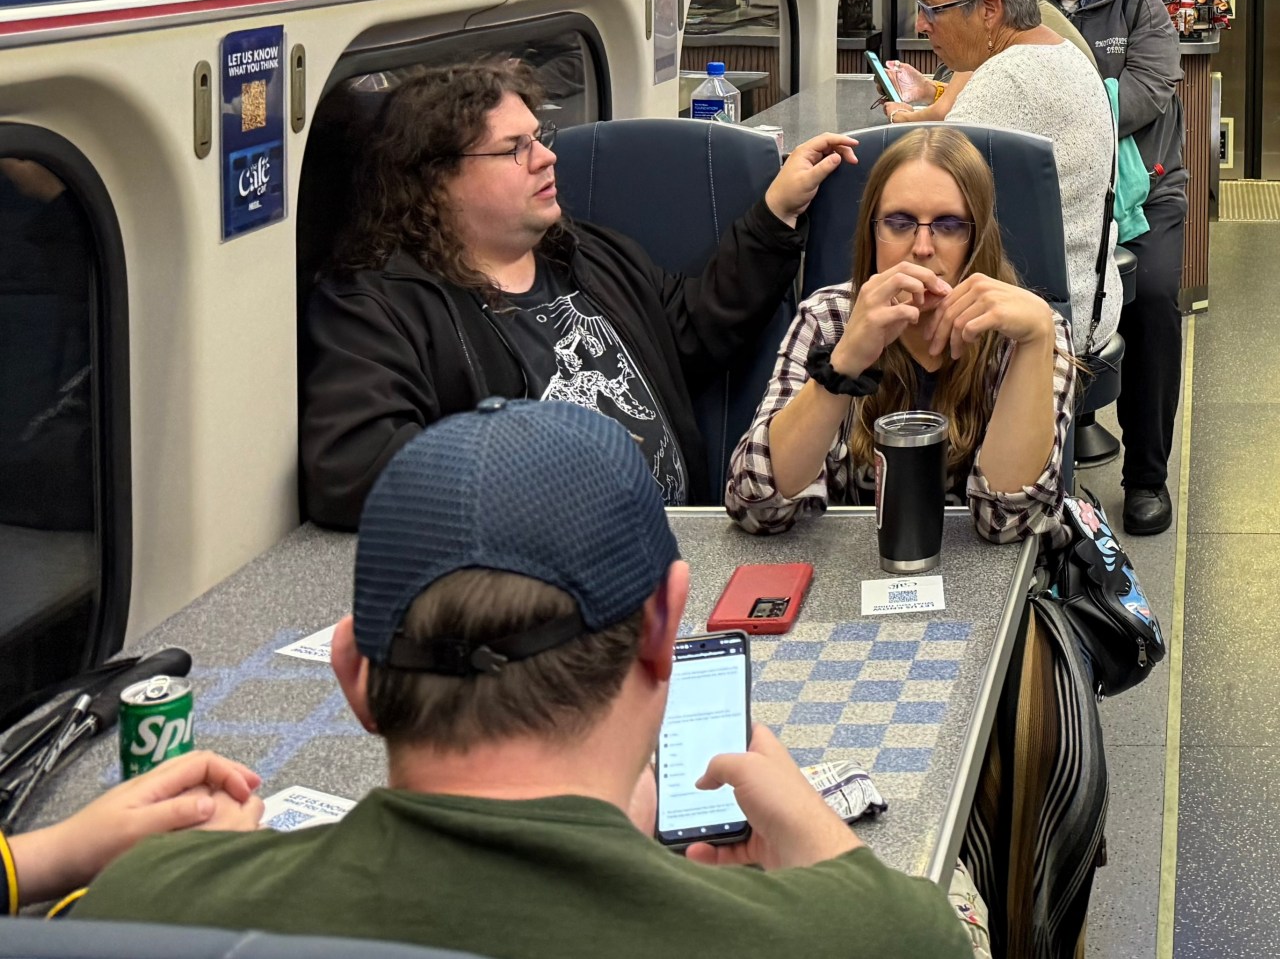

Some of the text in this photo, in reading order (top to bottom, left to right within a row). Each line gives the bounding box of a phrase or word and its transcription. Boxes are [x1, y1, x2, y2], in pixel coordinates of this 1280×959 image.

[228, 46, 278, 67] LET US KNOW
[229, 58, 278, 77] WHAT YOU THINK
[238, 156, 270, 197] Café
[257, 184, 267, 196] car
